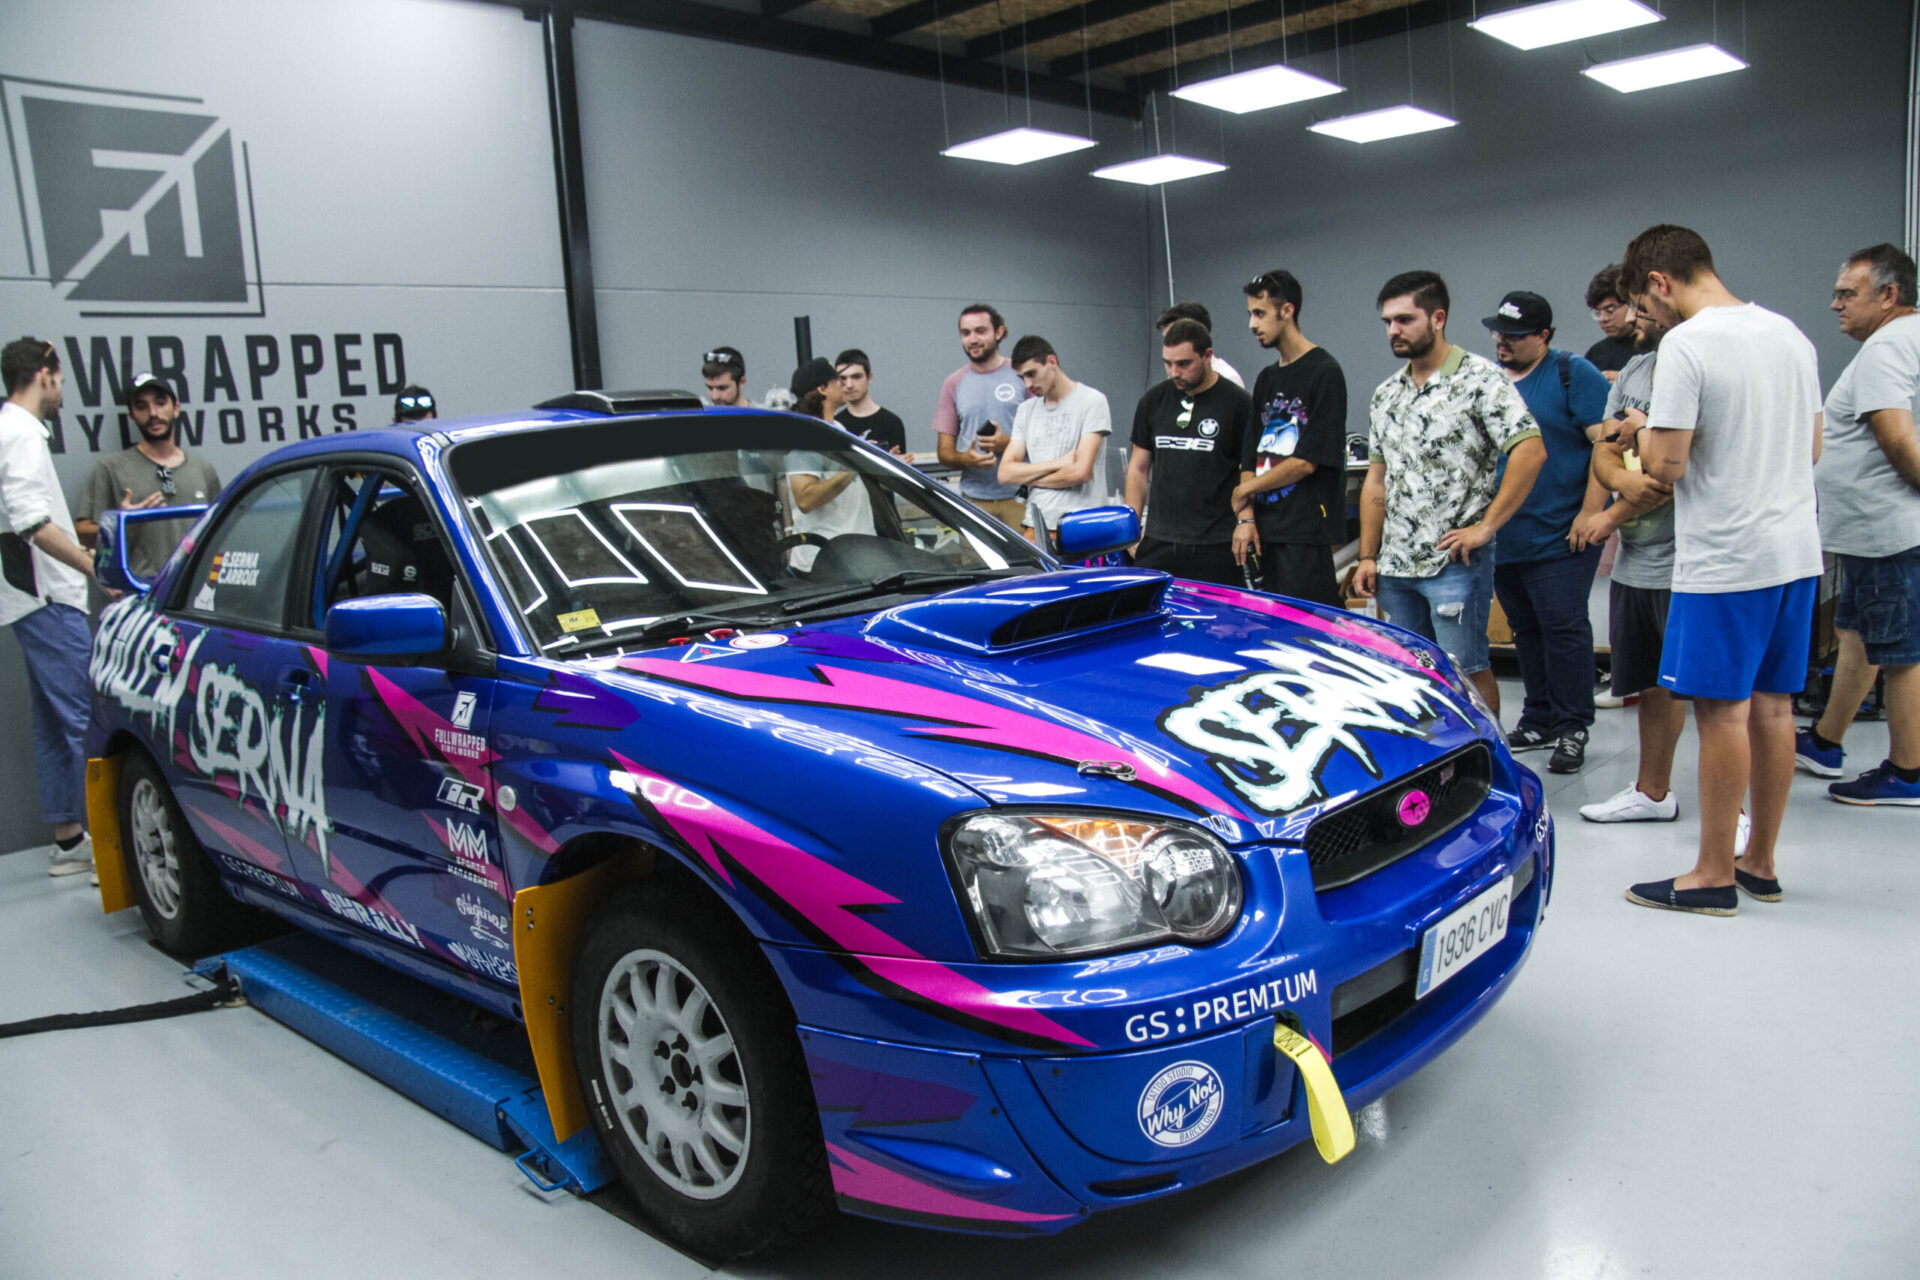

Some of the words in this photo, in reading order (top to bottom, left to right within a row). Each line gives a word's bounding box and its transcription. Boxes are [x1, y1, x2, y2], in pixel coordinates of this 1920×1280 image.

[0, 333, 407, 409] WRAPPED
[1155, 436, 1215, 452] E36
[434, 728, 486, 752] FULLWRAPPED
[189, 662, 335, 880] SERNA
[446, 817, 489, 864] MM
[447, 864, 498, 890] MANAGEMENT
[455, 856, 487, 875] SPORTS
[1437, 914, 1477, 973] 1936
[1478, 893, 1508, 943] CVC
[1125, 969, 1318, 1043] GS:PREMIUM
[1147, 1076, 1168, 1103] TATTOO
[1166, 1066, 1194, 1081] STUDIO
[1147, 1103, 1186, 1137] Why
[1189, 1074, 1217, 1110] Not
[1179, 1107, 1217, 1141] BARCELONA
